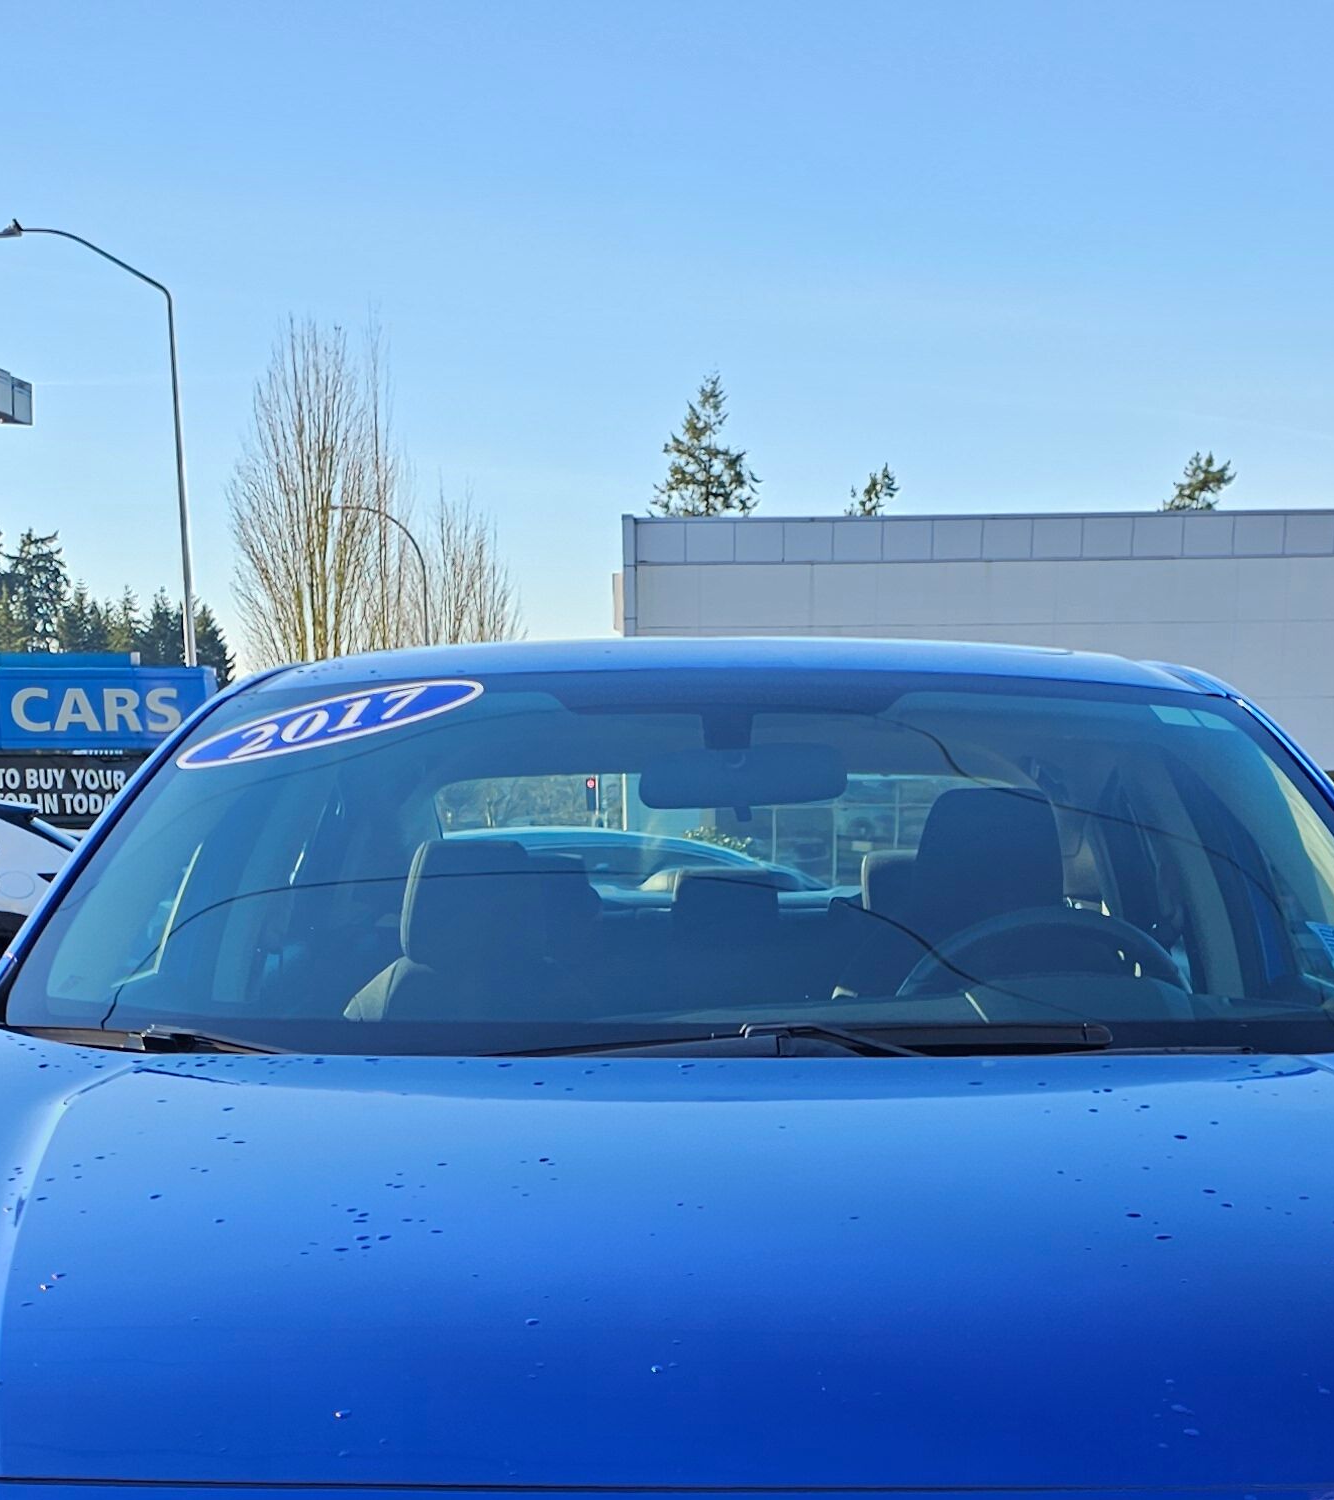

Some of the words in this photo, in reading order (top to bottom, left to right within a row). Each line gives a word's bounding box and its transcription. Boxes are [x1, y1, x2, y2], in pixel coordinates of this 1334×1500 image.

[10, 687, 182, 732] CARS
[228, 686, 427, 759] 2017
[25, 768, 65, 789] BUY
[71, 769, 127, 790] YOUR
[36, 793, 59, 814] IN
